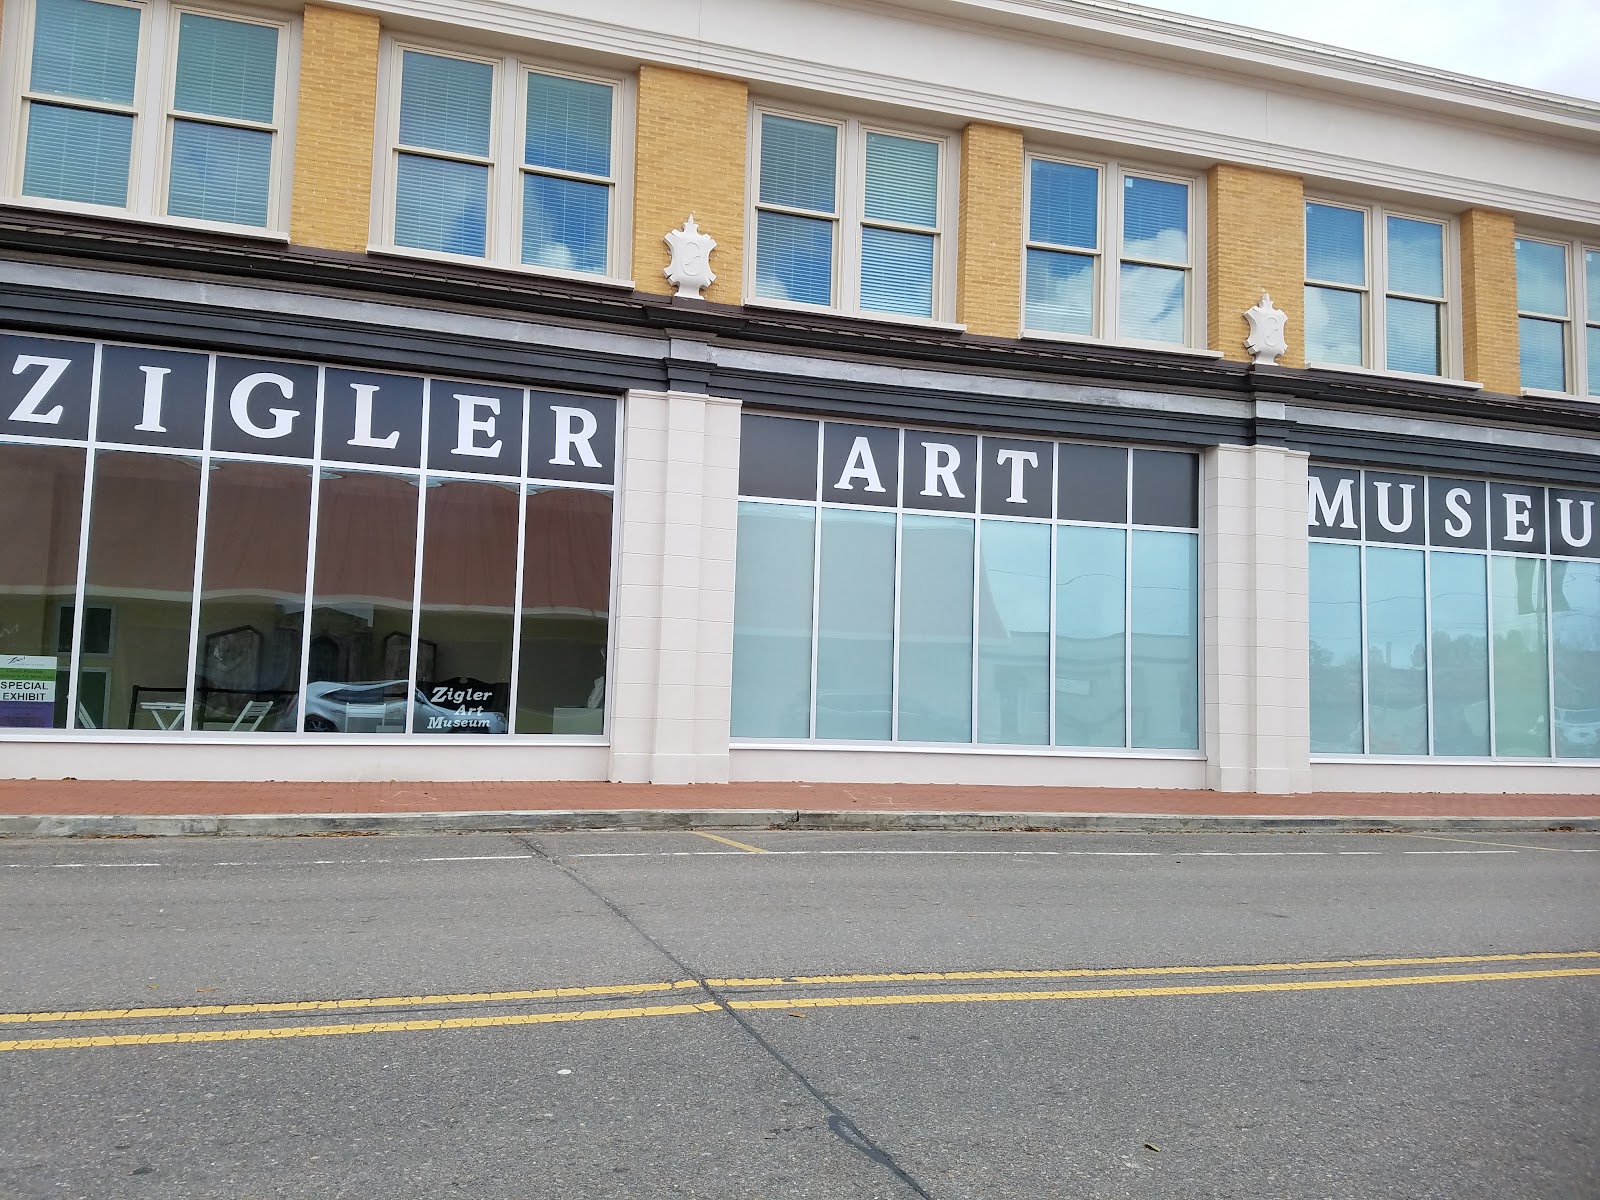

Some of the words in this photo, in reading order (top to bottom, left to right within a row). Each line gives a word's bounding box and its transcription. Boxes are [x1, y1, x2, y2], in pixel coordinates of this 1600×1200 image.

[8, 354, 603, 469] ZIGLER
[834, 436, 1039, 504] ART
[0, 681, 49, 690] SPECIAL
[2, 692, 47, 701] EXHIBIT
[430, 686, 493, 704] Zigler
[454, 704, 484, 716] Art
[427, 716, 491, 729] Museum
